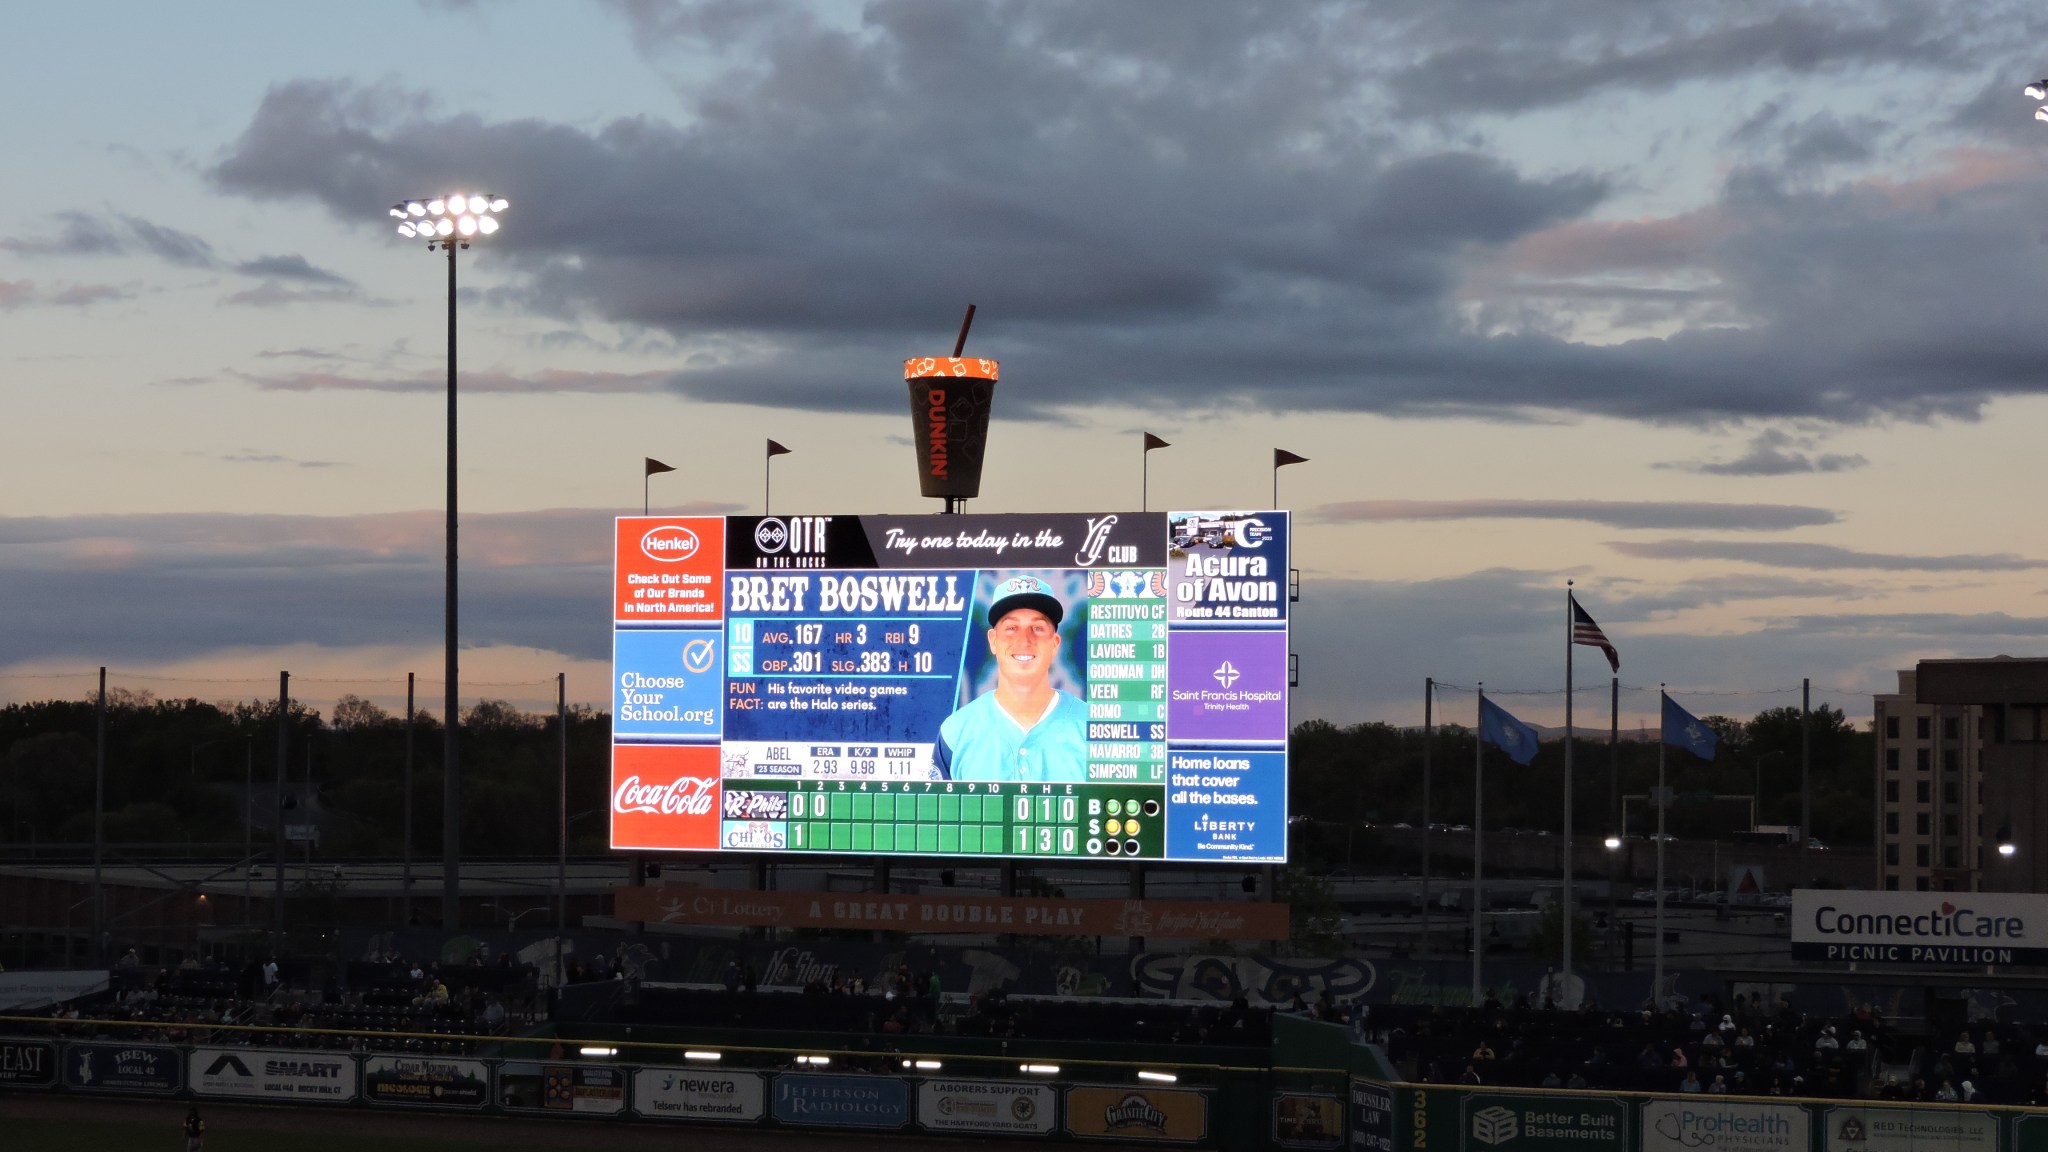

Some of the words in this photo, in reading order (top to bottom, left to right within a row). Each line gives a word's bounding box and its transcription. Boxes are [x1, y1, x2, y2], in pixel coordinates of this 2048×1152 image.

[790, 517, 826, 553] OTR
[886, 528, 918, 555] Try
[921, 536, 953, 548] one
[956, 529, 1009, 555] today
[1012, 533, 1033, 547] in
[1035, 528, 1064, 547] the
[646, 537, 694, 550] Henkel
[774, 557, 790, 568] THE
[796, 557, 826, 568] ROCKS
[1108, 546, 1137, 563] CLUB
[1185, 553, 1268, 577] Acura
[628, 574, 659, 584] Check
[662, 574, 680, 584] Out
[682, 574, 711, 584] Some
[634, 588, 646, 598] of
[647, 588, 666, 598] Our
[668, 588, 704, 598] Brands
[731, 576, 809, 611] BRET
[819, 576, 965, 611] BOSWELL
[1176, 578, 1205, 602] of
[1208, 578, 1277, 602] Avon
[636, 602, 666, 612] North
[668, 602, 714, 612] America!
[1090, 604, 1149, 619] RESTITUYO
[1151, 604, 1165, 619] CF
[1176, 606, 1213, 618] Route
[1214, 606, 1231, 618] 44
[1232, 606, 1278, 618] Canton
[733, 624, 752, 643] 10
[835, 632, 852, 644] HR
[856, 624, 867, 645] 3
[885, 632, 904, 644] RBI
[908, 624, 920, 645] 9
[1090, 623, 1132, 639] DATRES
[1151, 623, 1165, 639] 2B
[1090, 643, 1136, 659] LAVIGNE
[1152, 643, 1165, 659] 1B
[733, 652, 751, 672] SS
[898, 660, 908, 671] H
[914, 652, 932, 673] 10
[1090, 664, 1144, 679] GOODMAN
[1151, 664, 1165, 679] DH
[621, 672, 684, 688] Choose
[621, 689, 663, 704] Your
[729, 683, 755, 694] FUN
[768, 683, 785, 694] His
[788, 682, 832, 695] favorite
[834, 682, 867, 695] video
[869, 685, 908, 698] games
[1089, 684, 1118, 699] VEEN
[1151, 684, 1165, 699] RF
[1172, 690, 1200, 700] Saint
[1201, 690, 1238, 700] Francis
[1239, 690, 1281, 703] Hospital
[729, 698, 764, 710] FACT:
[767, 700, 787, 710] are
[790, 697, 808, 710] the
[811, 697, 838, 710] Halo
[841, 699, 877, 711] series.
[1089, 704, 1121, 719] ROMO
[1157, 704, 1165, 719] C
[1203, 703, 1225, 711] Trinity
[621, 705, 713, 725] School.org
[1089, 723, 1140, 739] BOSWELL
[1150, 724, 1164, 739] SS
[766, 746, 791, 761] ABEL
[817, 748, 834, 756] ERA
[854, 748, 872, 757] K/9
[887, 748, 912, 756] WHIP
[1089, 743, 1141, 759] NAVARRO
[1150, 744, 1164, 759] 3B
[769, 765, 800, 774] SEASON
[813, 759, 838, 774] 2.93
[850, 760, 875, 775] 9.98
[888, 761, 911, 775] 1.11
[1172, 756, 1212, 770] Home
[1213, 757, 1250, 770] loans
[1089, 764, 1137, 779] SIMPSON
[1151, 764, 1164, 779] LF
[881, 782, 888, 791] 5
[903, 782, 910, 792] 6
[925, 783, 932, 792] 7
[946, 783, 953, 792] 8
[968, 783, 976, 793] 9
[988, 783, 999, 793] 10
[1020, 784, 1028, 794] R
[1042, 784, 1051, 794] H
[1172, 774, 1200, 787] that
[1202, 776, 1240, 788] cover
[615, 775, 719, 814] Coca-Cola
[1172, 791, 1187, 804] all
[1189, 791, 1211, 804] the
[1213, 791, 1258, 805] bases.
[793, 794, 804, 817] 0
[814, 794, 825, 817] 0
[1017, 797, 1029, 820] 0
[1063, 798, 1074, 821] 0
[1088, 799, 1101, 815] B
[1088, 818, 1100, 835] S
[1194, 821, 1255, 831] LIBERTY
[1040, 828, 1051, 851] 3
[1063, 829, 1074, 852] 0
[1086, 838, 1102, 854] O
[1206, 843, 1238, 851] Community
[808, 901, 823, 918] A
[833, 901, 909, 920] GREAT
[920, 903, 1013, 923] DOUBLE
[1025, 907, 1084, 925] PLAY
[1815, 904, 2025, 938] ConnectiCare
[1827, 945, 1899, 960] PICNIC
[1912, 947, 2012, 963] PAVILION
[114, 1049, 159, 1064] IBEW
[117, 1065, 144, 1075] LOCAL
[264, 1060, 342, 1078] SMART
[679, 1079, 709, 1093] new
[711, 1081, 734, 1093] era
[782, 1083, 879, 1101] JEFFERSON
[933, 1084, 988, 1094] LABORERS
[990, 1085, 1040, 1096] SUPPORT
[652, 1100, 682, 1111] Telserv
[683, 1102, 698, 1112] has
[792, 1098, 902, 1114] RADIOLOGY
[1352, 1090, 1391, 1112] DRESSLER
[950, 1119, 990, 1128] HARTFORD
[1362, 1108, 1380, 1125] LAW
[1524, 1111, 1573, 1124] Better
[1580, 1113, 1615, 1127] Built
[1682, 1111, 1789, 1134] ProHealth
[1524, 1125, 1615, 1140] Basements
[1873, 1121, 1895, 1131] RED
[1898, 1122, 1964, 1134] TECHNOLOGIES
[1717, 1136, 1789, 1145] PHYSICIANS
